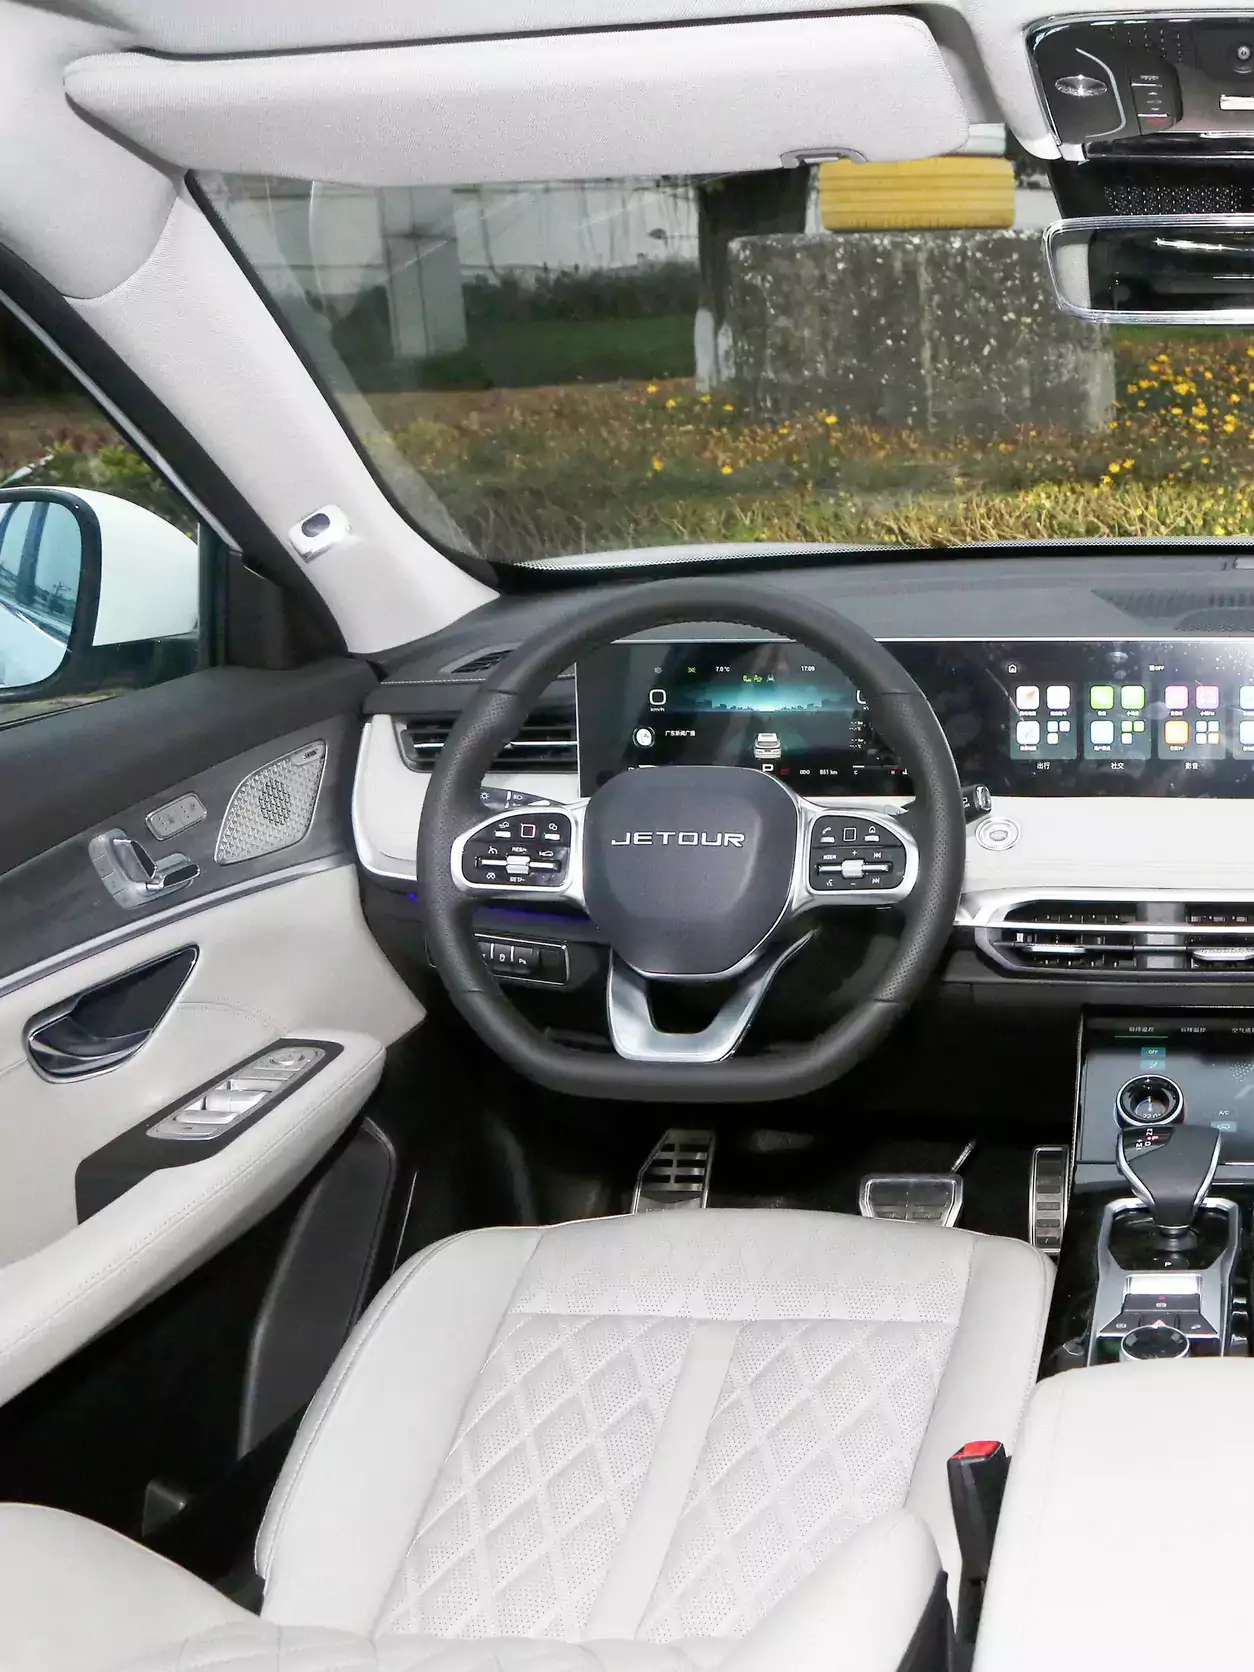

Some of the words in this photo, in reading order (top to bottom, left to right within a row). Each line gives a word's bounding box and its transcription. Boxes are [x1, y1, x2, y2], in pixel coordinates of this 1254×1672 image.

[762, 763, 775, 772] P
[1036, 762, 1050, 770] 出行
[1111, 762, 1125, 770] 社交
[1185, 762, 1199, 770] 影音
[611, 831, 746, 848] JETOUR
